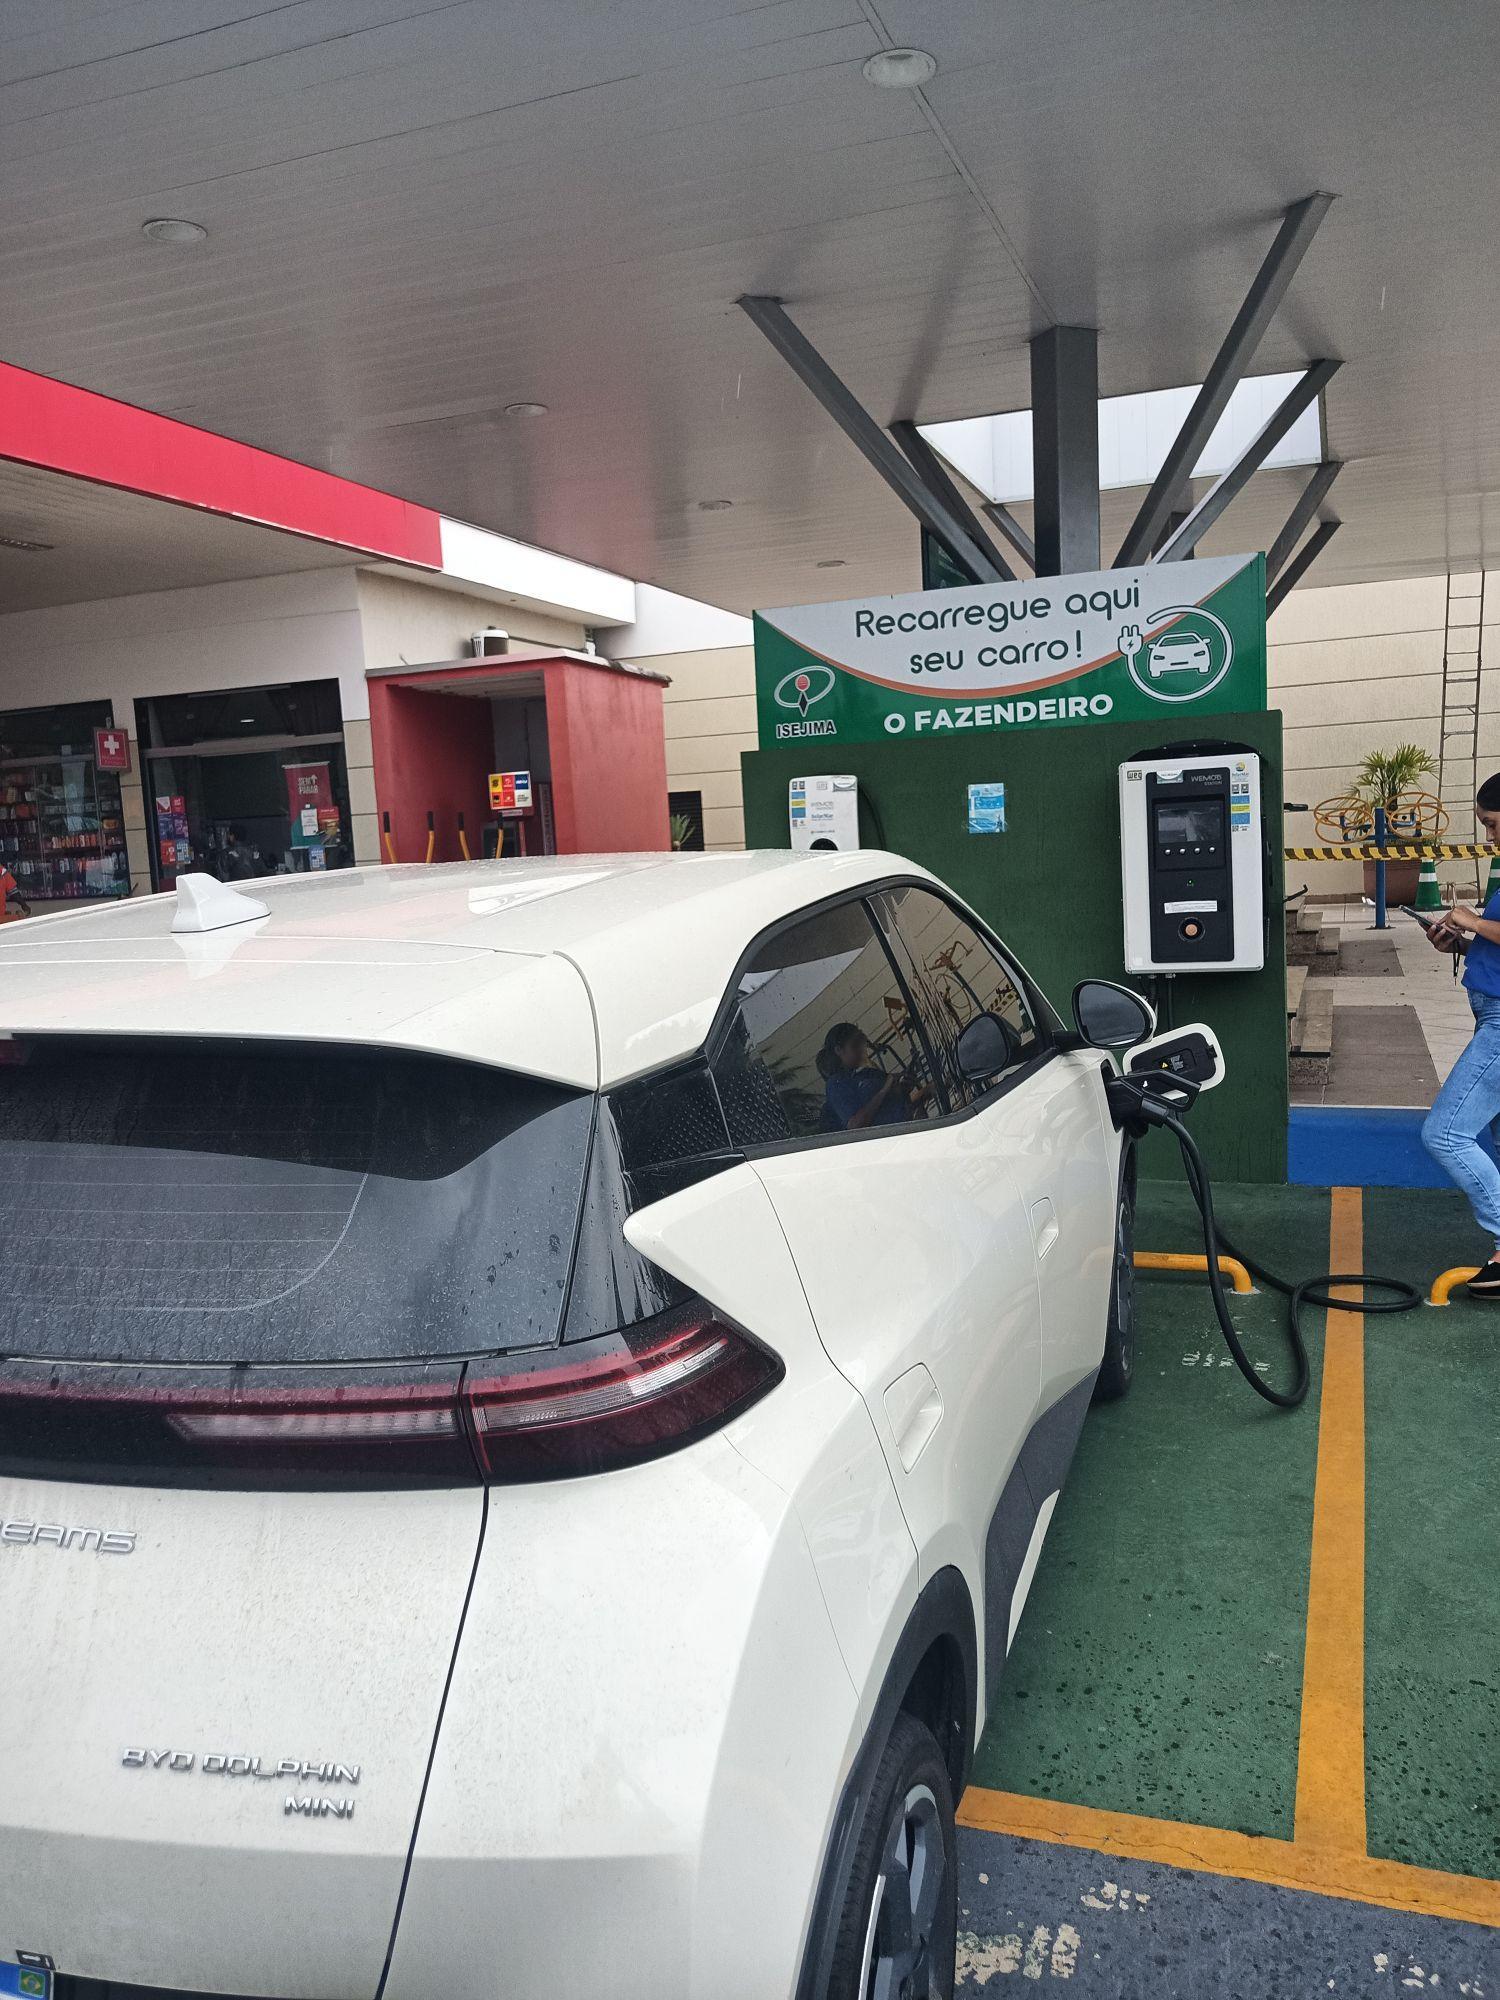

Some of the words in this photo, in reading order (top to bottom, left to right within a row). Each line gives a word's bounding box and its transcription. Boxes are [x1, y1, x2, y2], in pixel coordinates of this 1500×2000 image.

[855, 597, 1051, 638] Recarregue
[1065, 578, 1139, 621] aqui
[910, 650, 964, 674] seu
[776, 720, 837, 738] ISEJIMA
[883, 713, 906, 734] O
[914, 693, 1114, 731] FAZENDEIRO
[0, 1520, 137, 1554] EAMS
[122, 1747, 195, 1771] BYD
[202, 1753, 361, 1785] DOLPHIN
[284, 1795, 356, 1819] MINI
